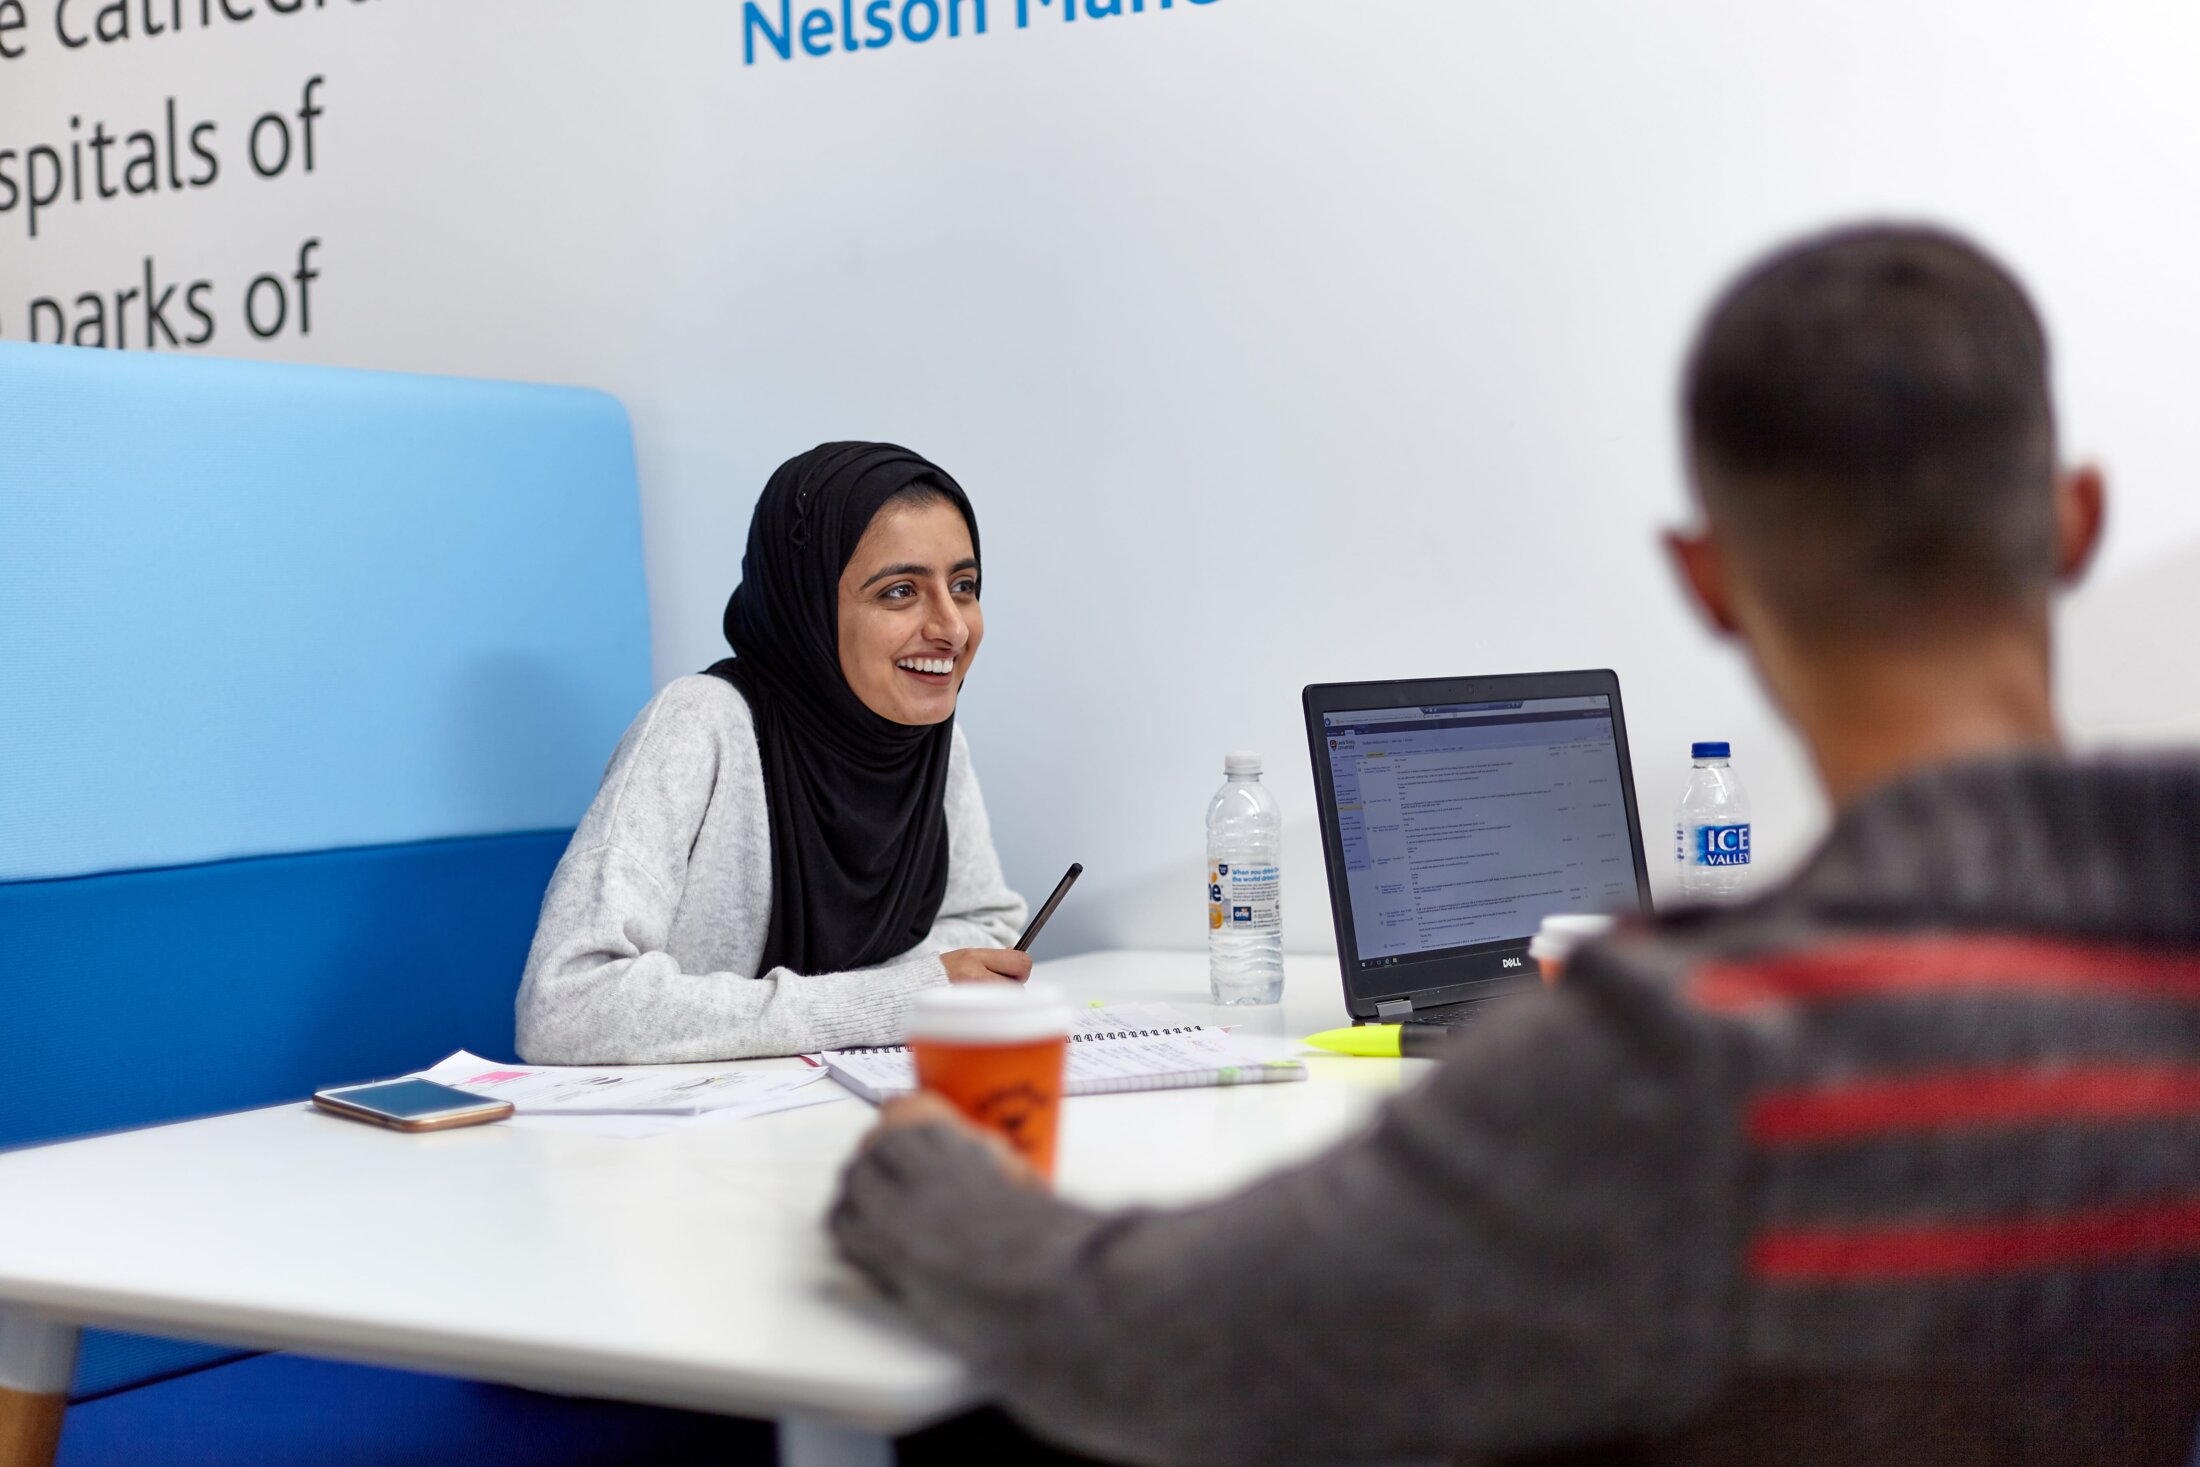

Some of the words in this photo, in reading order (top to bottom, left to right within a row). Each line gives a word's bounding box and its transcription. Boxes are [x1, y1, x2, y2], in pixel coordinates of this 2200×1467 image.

[742, 0, 988, 66] Nelson
[248, 75, 325, 179] of
[244, 238, 321, 339] of
[1707, 853, 1749, 865] VALLEY
[1708, 828, 1749, 851] ICE
[1503, 957, 1522, 968] DELL
